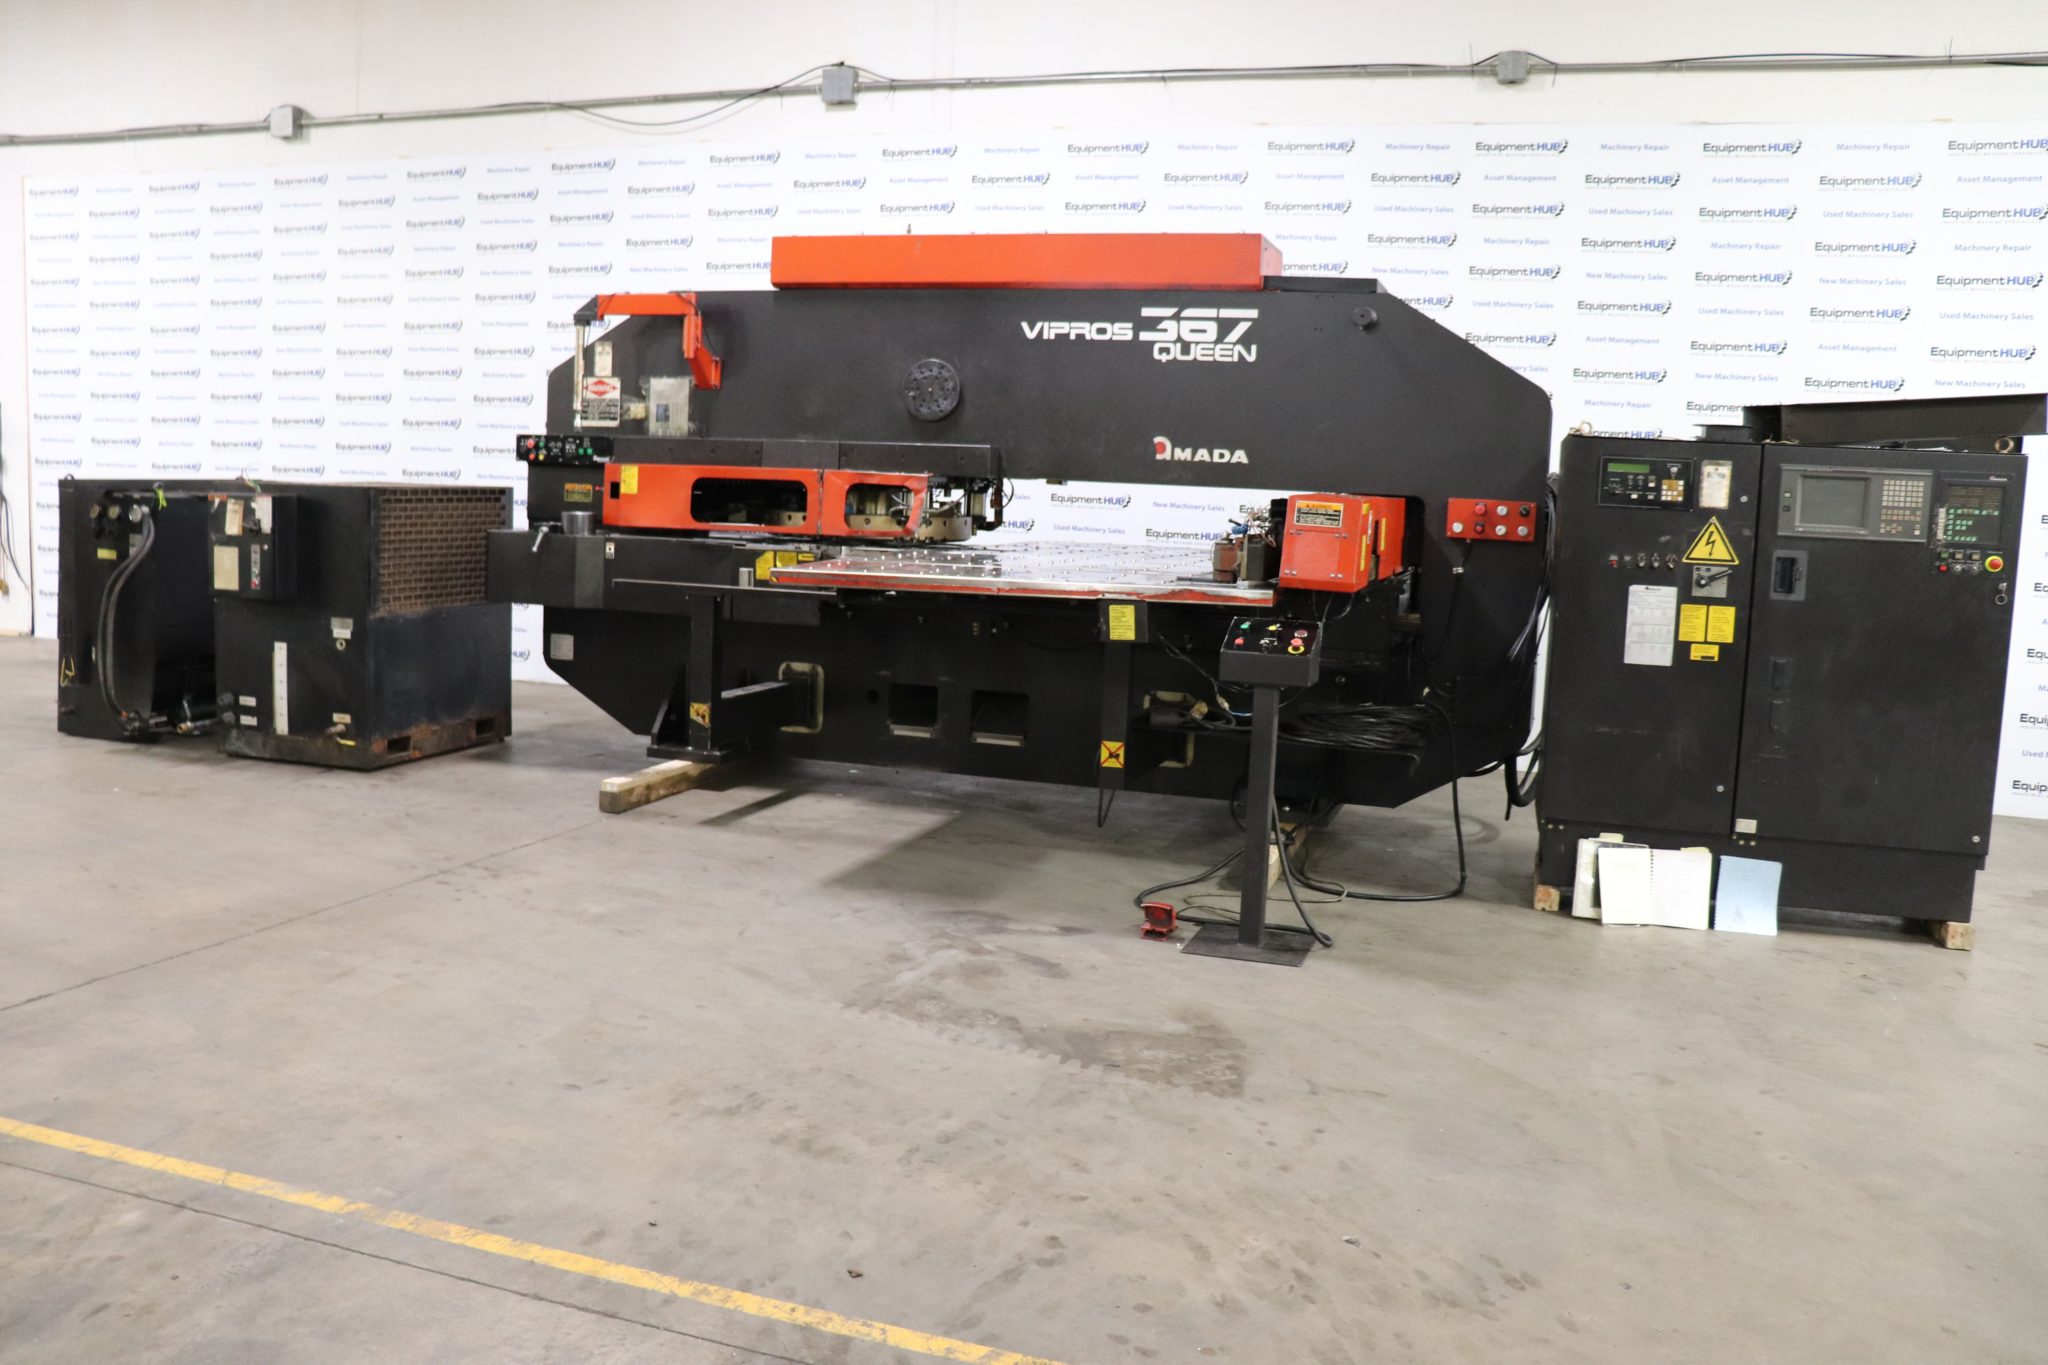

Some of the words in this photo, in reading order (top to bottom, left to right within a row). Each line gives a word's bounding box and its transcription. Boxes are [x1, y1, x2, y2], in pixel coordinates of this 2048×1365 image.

[1021, 321, 1133, 340] VIPROS
[1139, 307, 1259, 343] 367
[1153, 342, 1257, 362] QUEEN
[1153, 436, 1249, 464] AMADA
